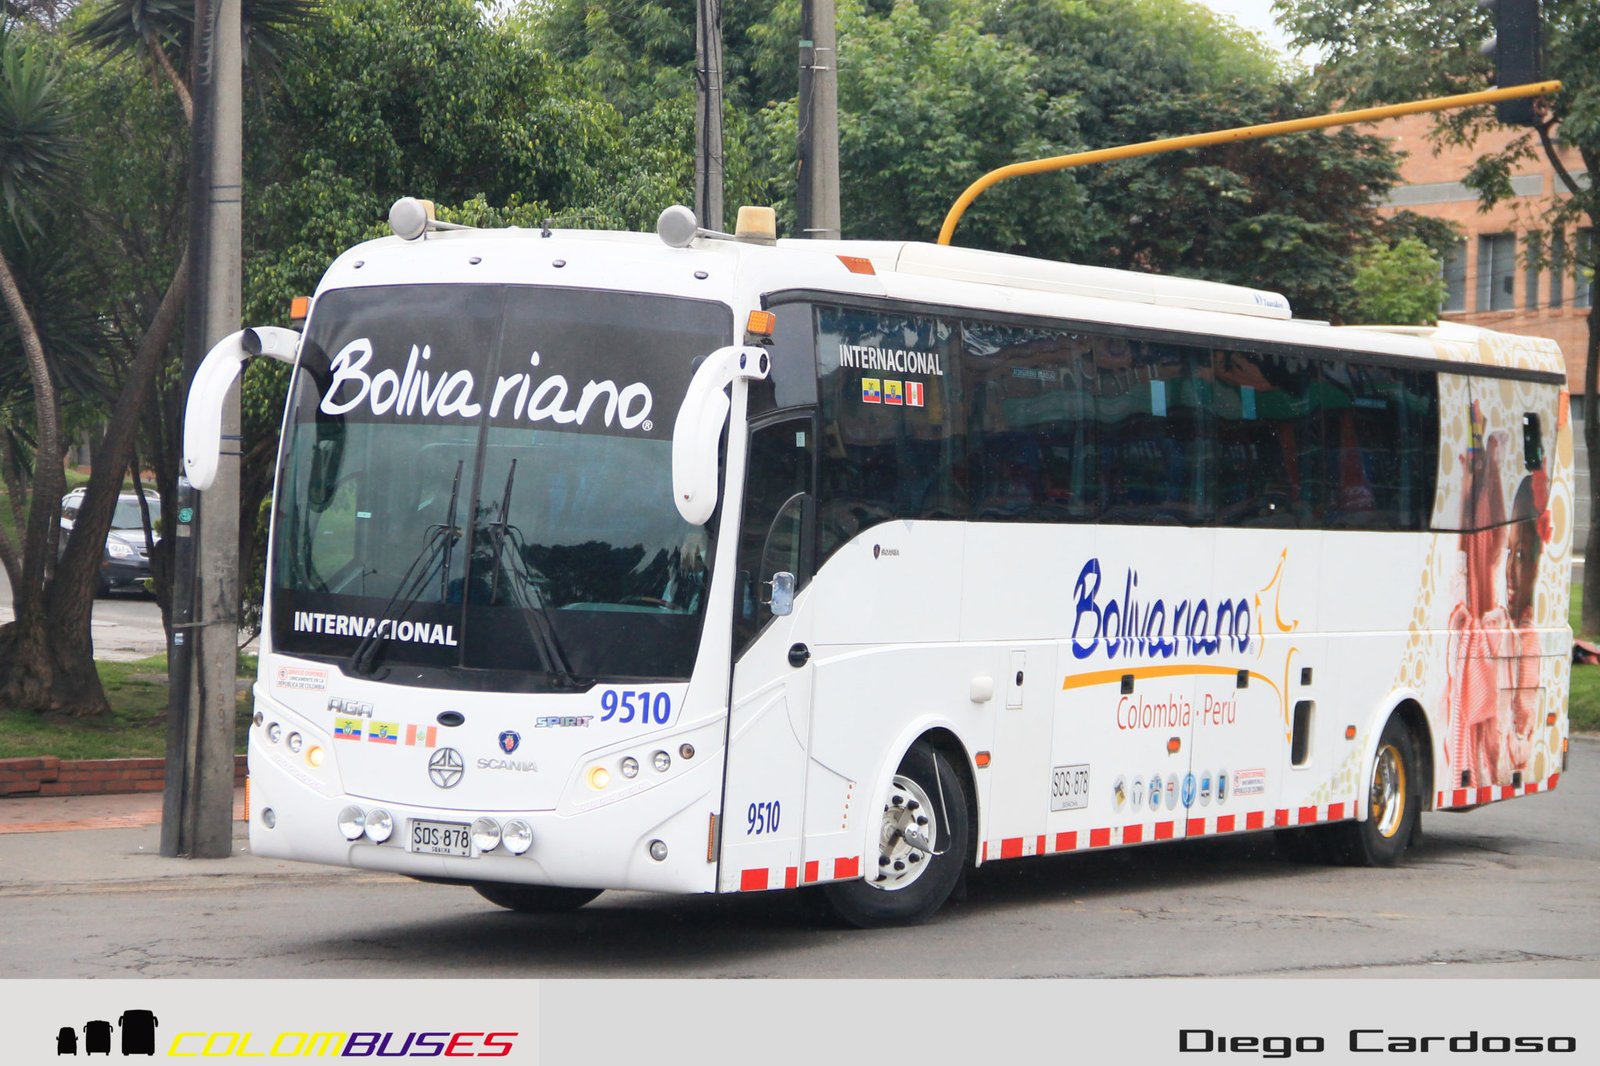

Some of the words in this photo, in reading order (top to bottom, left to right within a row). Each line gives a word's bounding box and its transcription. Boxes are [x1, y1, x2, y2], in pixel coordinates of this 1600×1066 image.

[839, 344, 943, 376] INTERNACIONAL
[321, 337, 653, 431] Bolivariano
[294, 611, 457, 646] INTERNACIONAL
[327, 696, 373, 718] AGA
[534, 715, 594, 728] SPIRIT
[600, 689, 671, 725] 9510
[1117, 693, 1190, 730] Colombia
[1204, 692, 1236, 725] Perú
[477, 758, 538, 773] SCANIA
[748, 800, 780, 834] 9510
